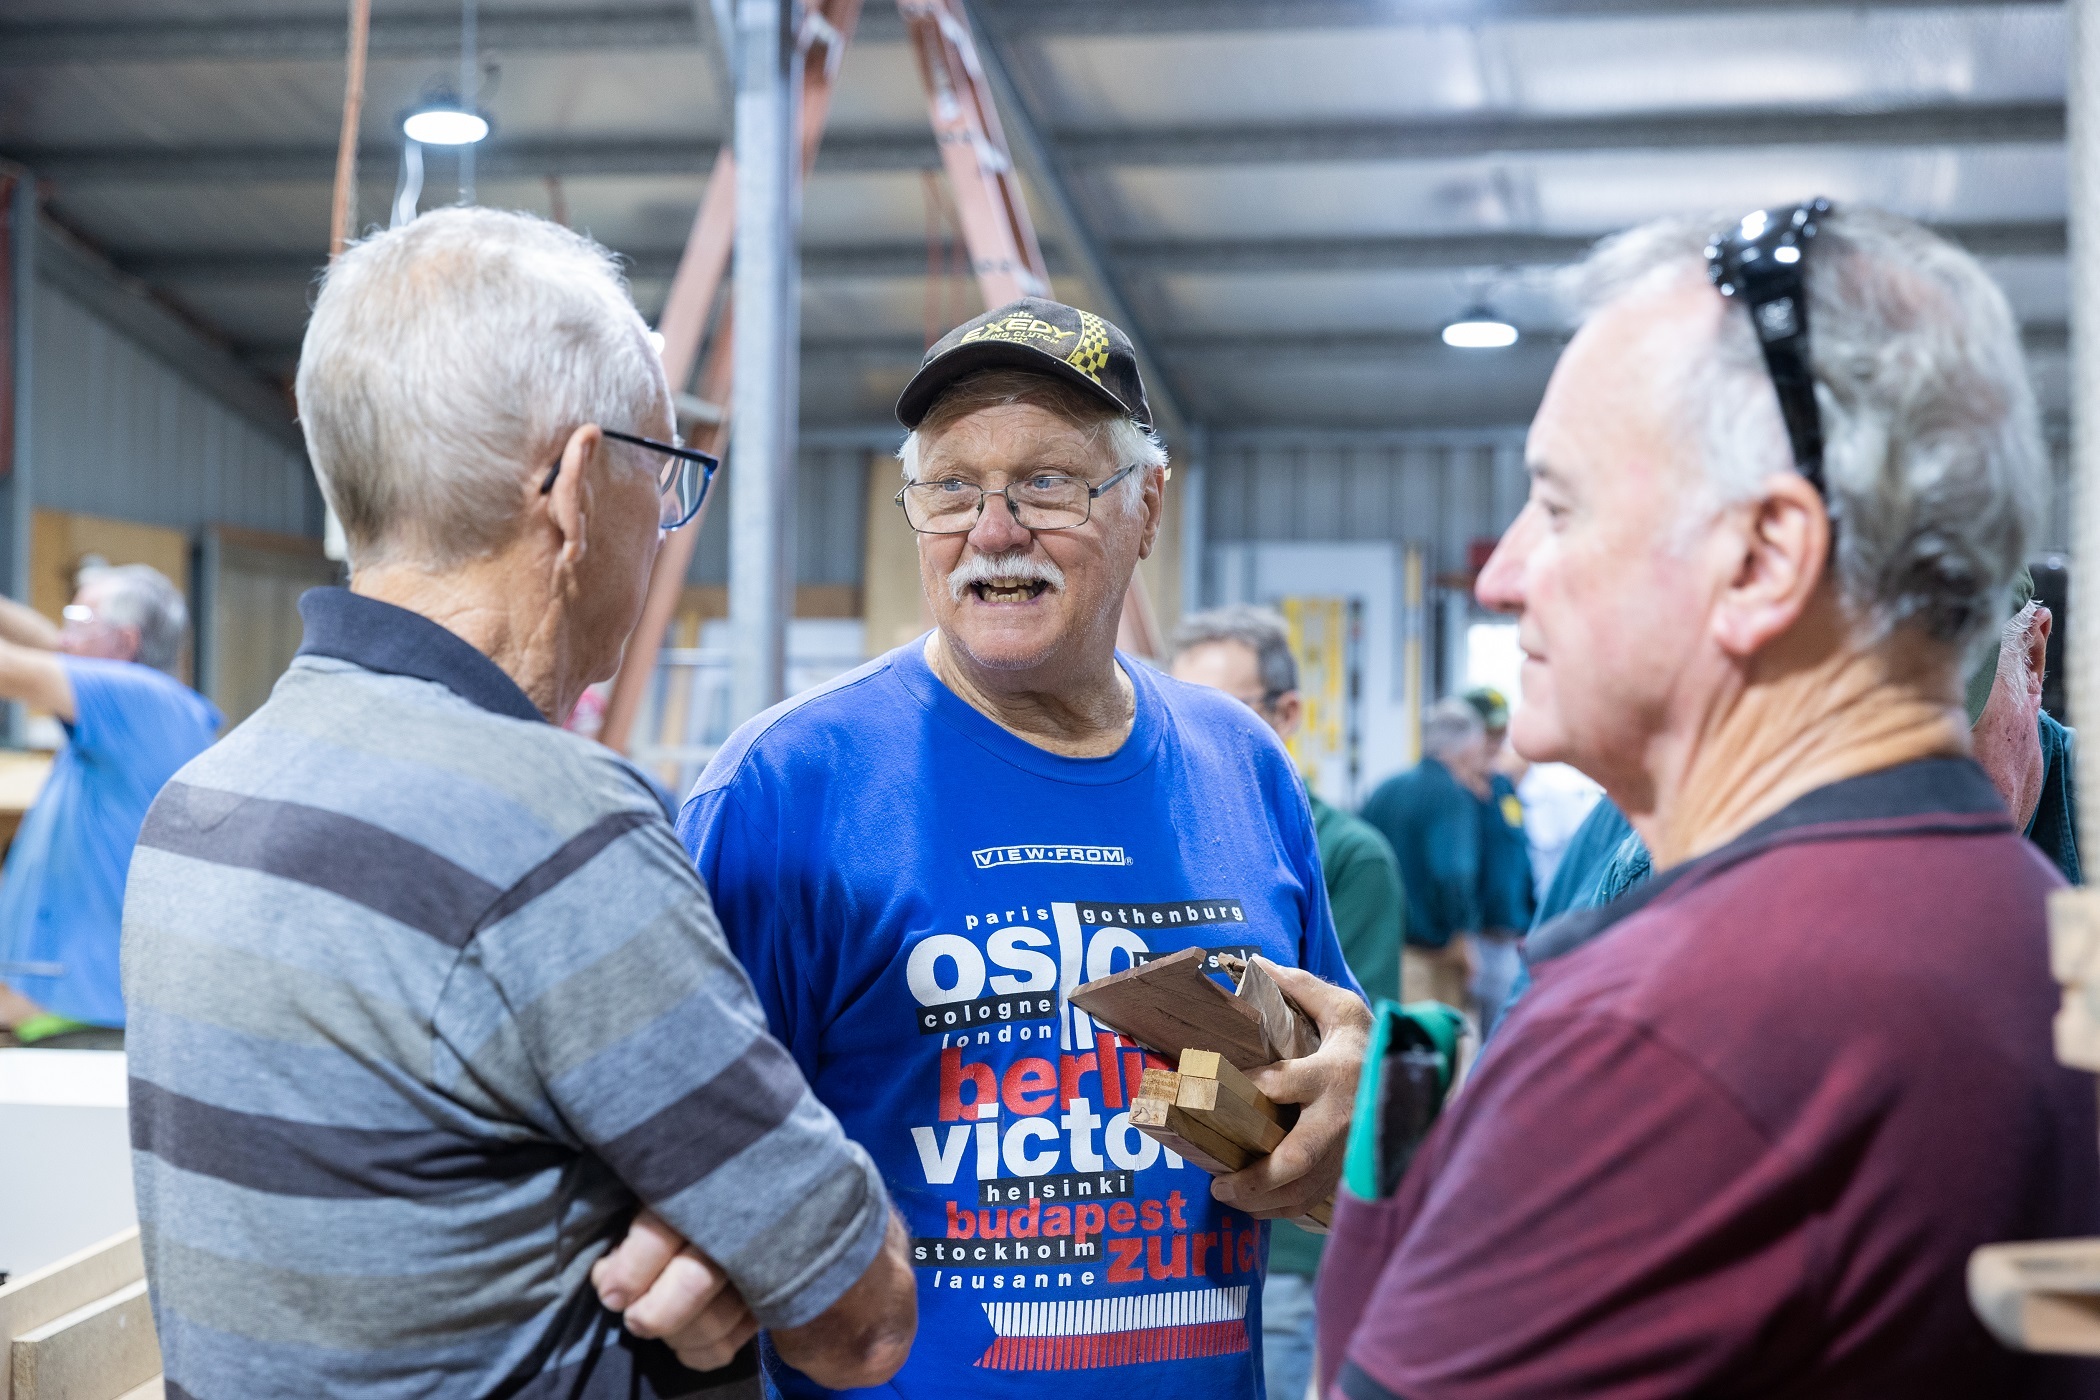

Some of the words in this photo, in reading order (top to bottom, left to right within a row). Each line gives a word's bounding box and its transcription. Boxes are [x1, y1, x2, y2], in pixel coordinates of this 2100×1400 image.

[961, 318, 1076, 344] EXEDY
[1013, 330, 1060, 344] CLUTCH
[966, 906, 1049, 930] paris
[1083, 905, 1244, 924] gothenburg
[924, 999, 1051, 1028] cologne
[942, 1024, 1052, 1050] london
[939, 1032, 1179, 1121] berli
[987, 1175, 1127, 1202] helsinki
[946, 1190, 1187, 1244] budapest
[914, 1240, 1095, 1261] stockholm
[934, 1270, 1095, 1289] lausanne
